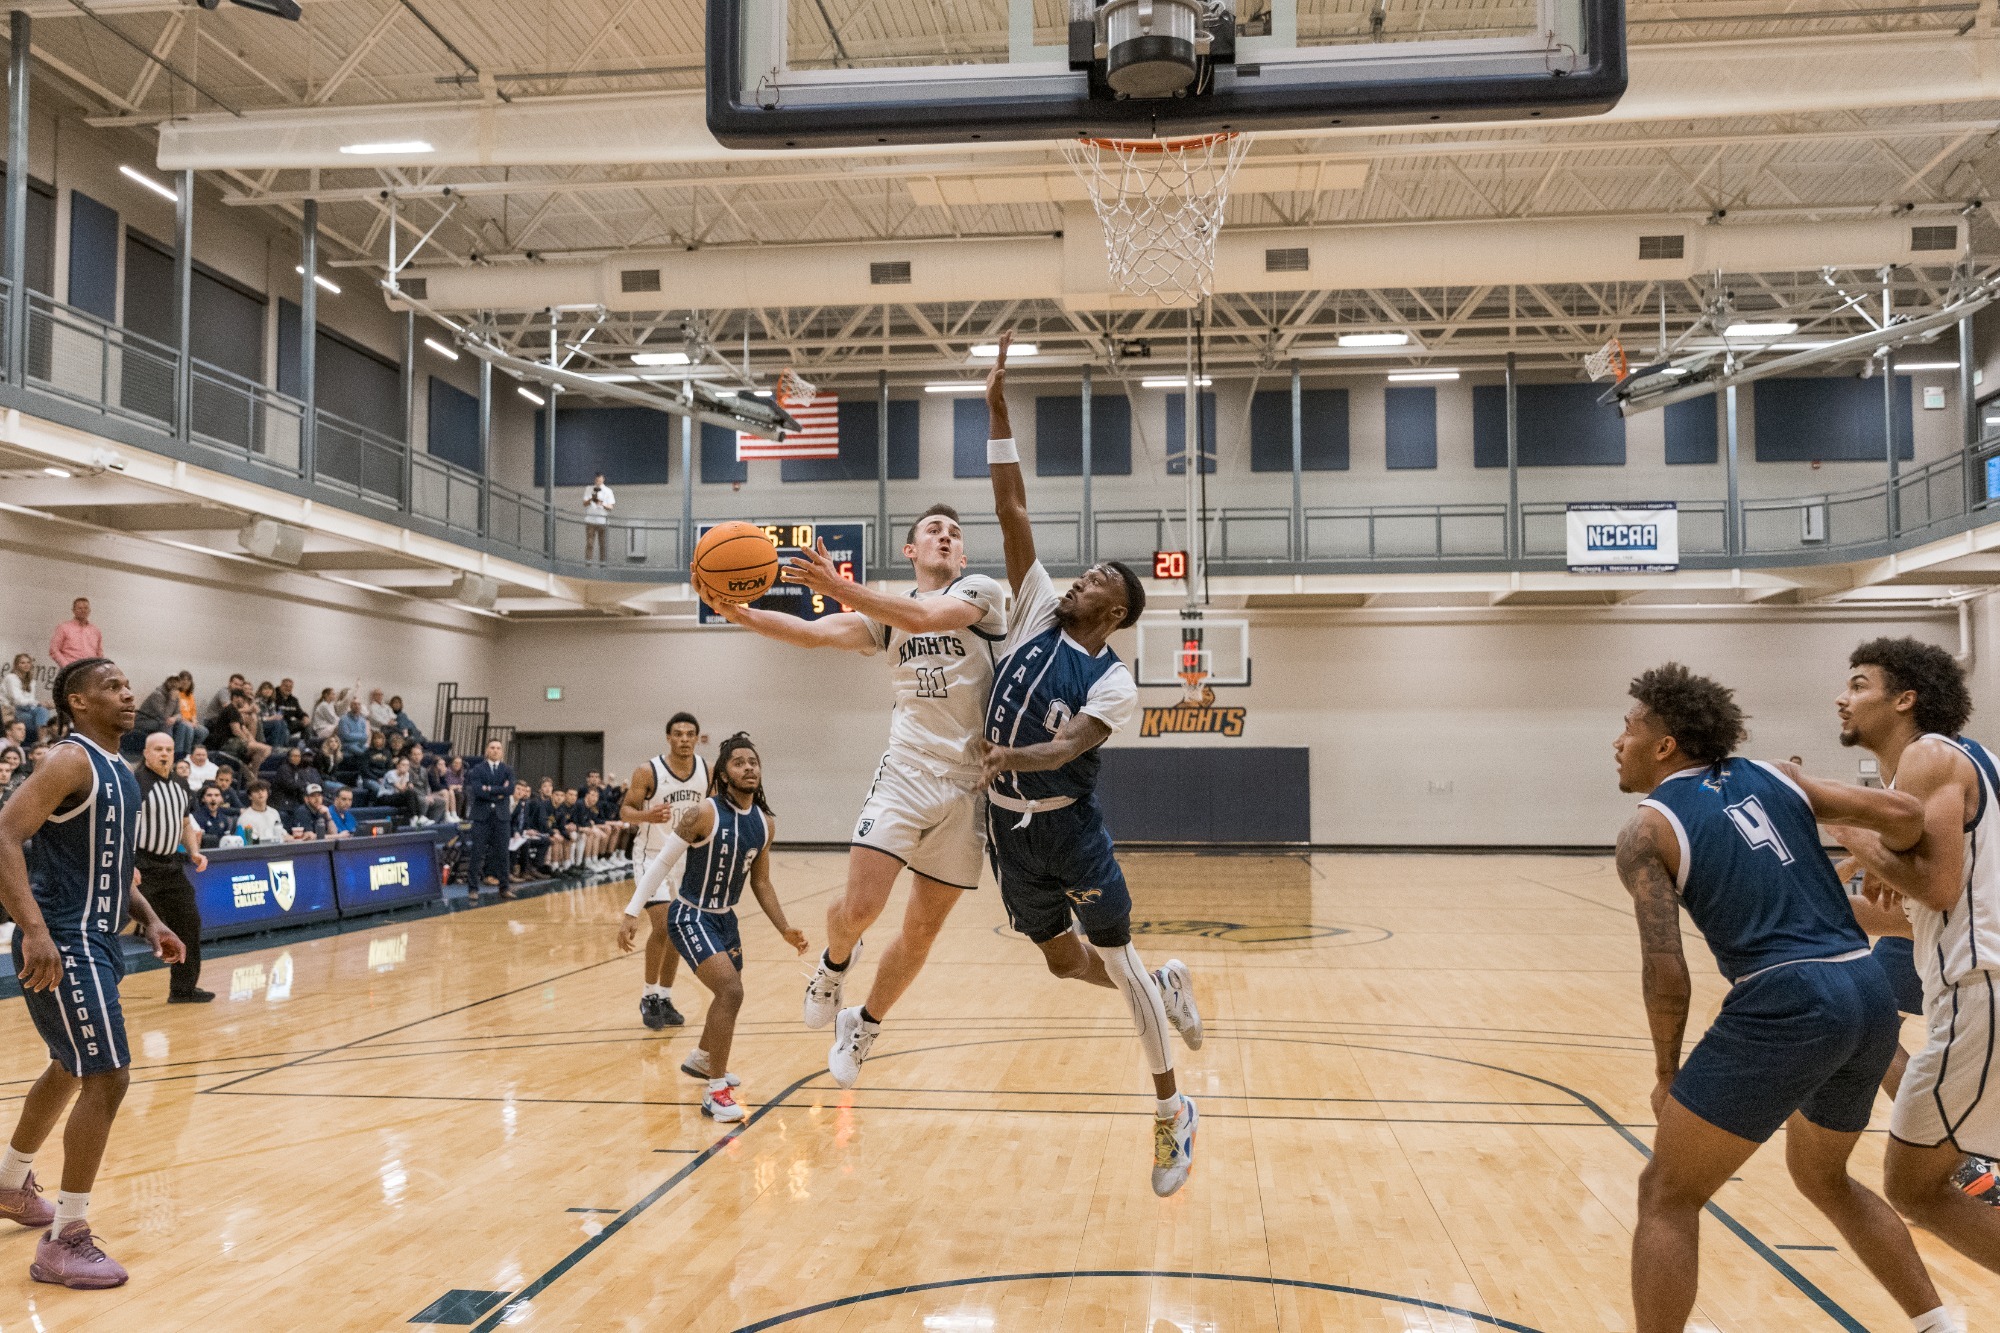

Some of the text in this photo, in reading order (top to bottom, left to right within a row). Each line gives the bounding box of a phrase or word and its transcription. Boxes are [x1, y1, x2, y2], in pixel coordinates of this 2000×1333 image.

[1587, 525, 1656, 547] NCCAA
[1156, 553, 1185, 578] 20
[728, 575, 767, 591] NCAA
[812, 594, 825, 614] 5
[916, 666, 948, 698] 11
[1140, 707, 1246, 737] KNIGHTS
[663, 789, 702, 804] KNIGHTS
[1723, 794, 1795, 866] 4
[96, 782, 116, 933] FALCONS
[369, 862, 409, 891] KNIGHTS
